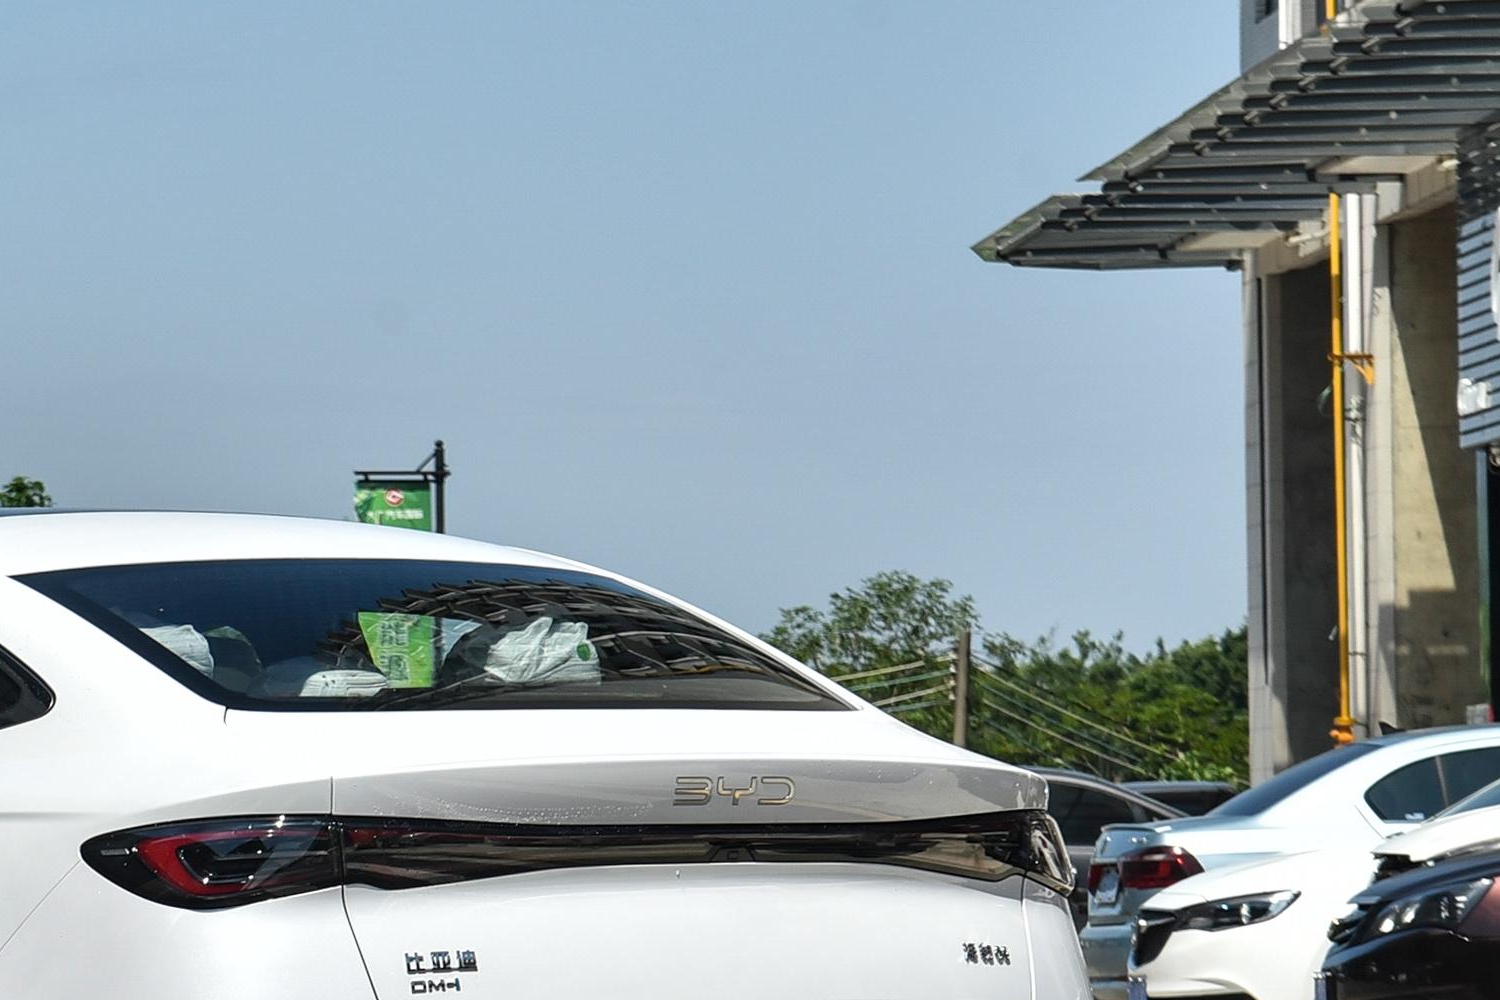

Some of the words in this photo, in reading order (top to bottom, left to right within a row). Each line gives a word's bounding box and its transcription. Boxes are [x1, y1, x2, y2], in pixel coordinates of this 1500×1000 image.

[673, 776, 796, 806] BYD
[404, 950, 478, 975] 比亚迪
